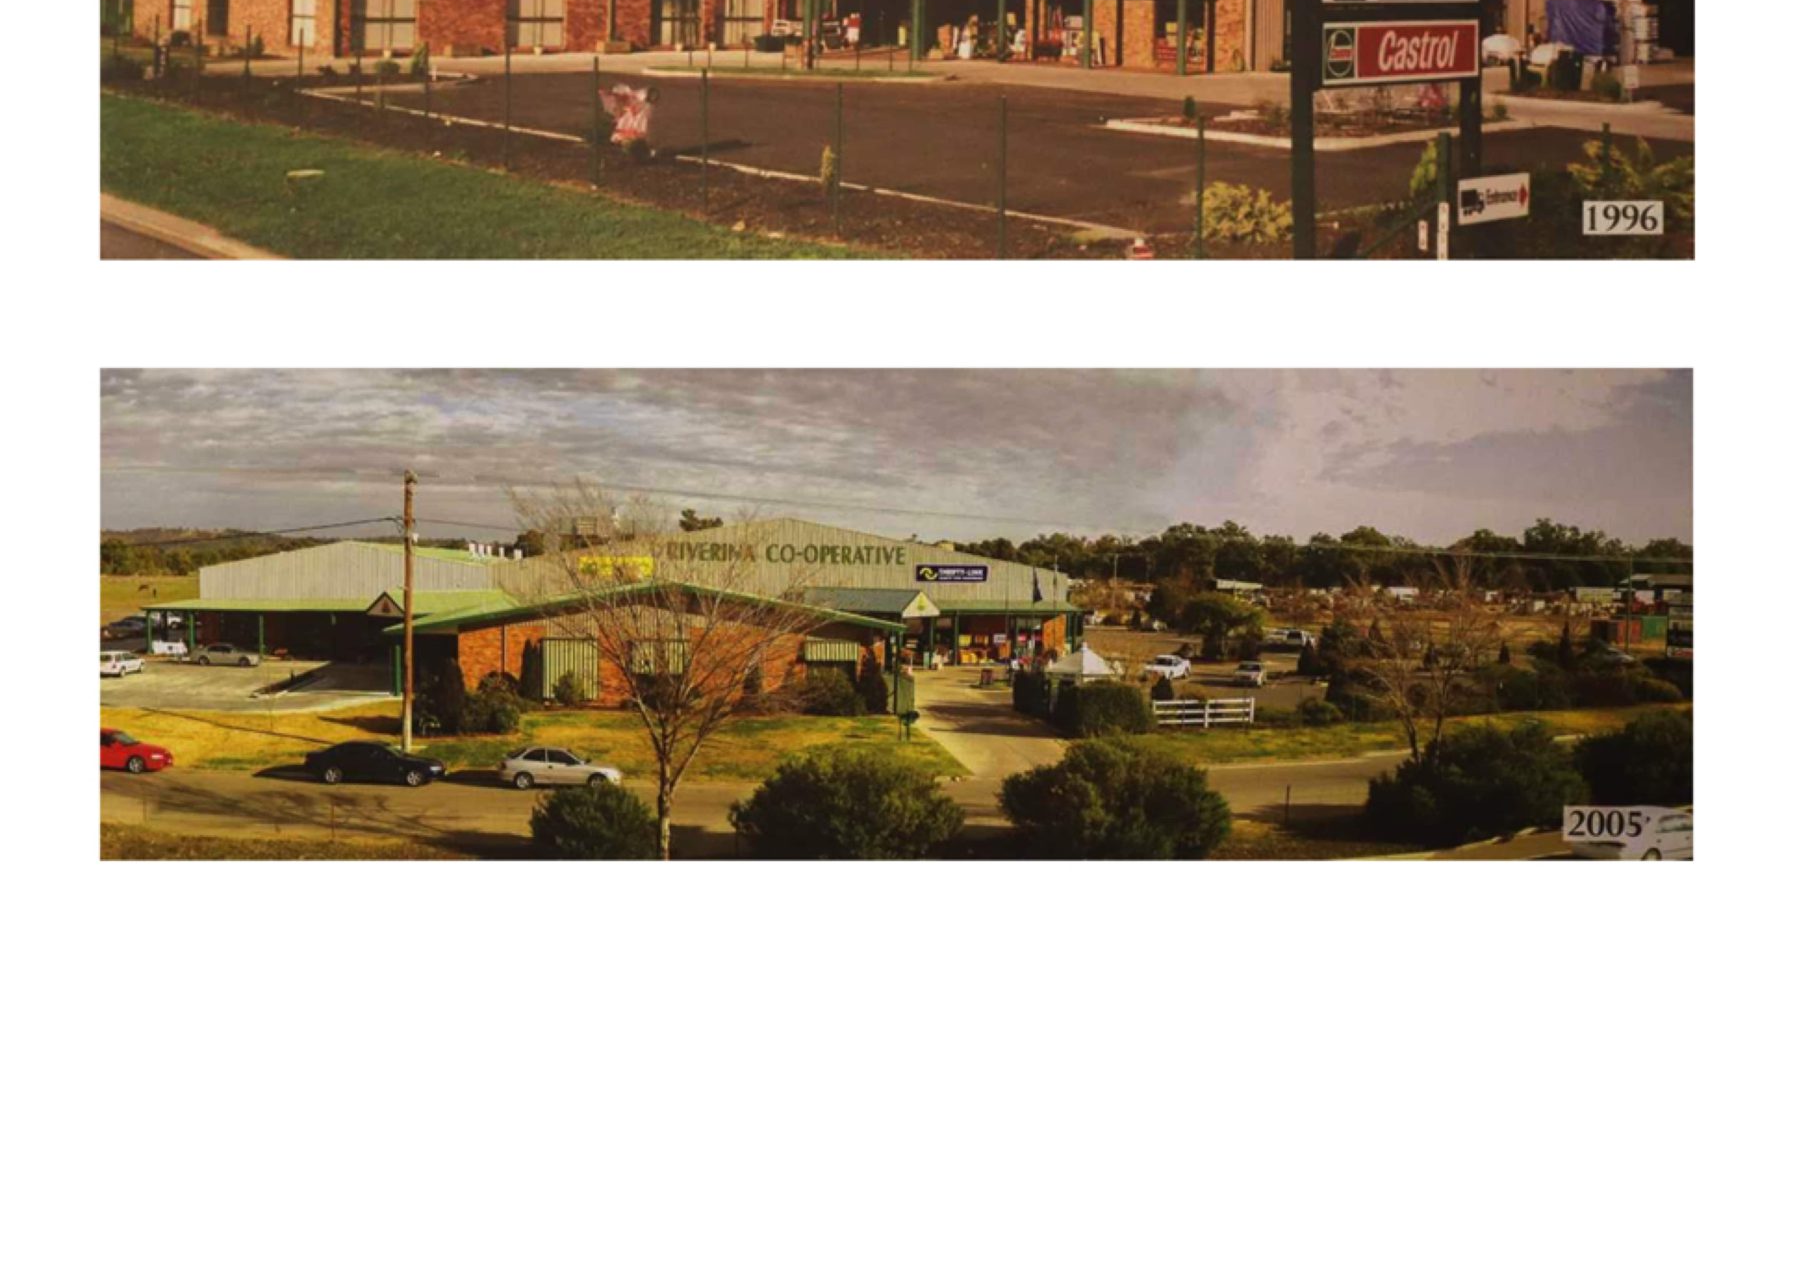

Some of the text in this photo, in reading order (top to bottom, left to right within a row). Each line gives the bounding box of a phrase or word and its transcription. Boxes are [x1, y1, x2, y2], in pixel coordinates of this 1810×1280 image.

[1378, 29, 1459, 71] Castrol
[666, 542, 906, 566] RIVERINA CO-OPERATIVE
